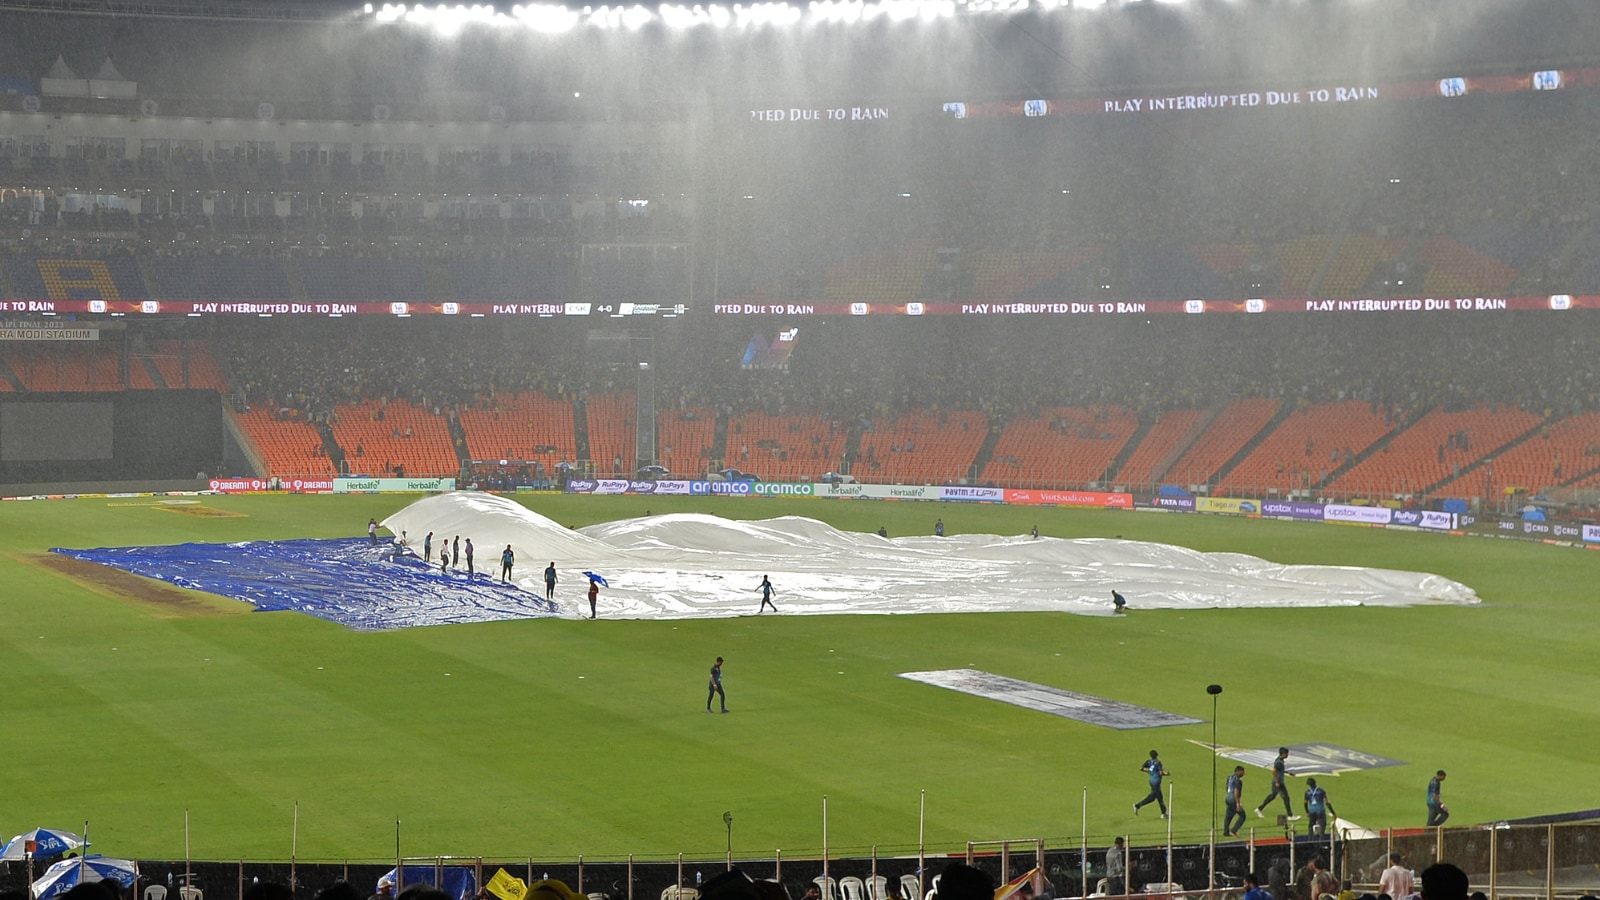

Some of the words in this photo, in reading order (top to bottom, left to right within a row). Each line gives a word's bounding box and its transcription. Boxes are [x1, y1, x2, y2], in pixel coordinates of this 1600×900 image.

[1104, 99, 1143, 112] PLAY
[1149, 93, 1261, 110] INTERRUPTED
[1307, 89, 1329, 102] TO
[1335, 87, 1379, 101] RAIN
[827, 109, 846, 120] TO
[851, 107, 889, 120] RAIN
[12, 301, 26, 311] TO
[29, 301, 55, 311] RAIN
[193, 303, 218, 312] PLAY
[221, 303, 289, 313] INTERRUPTED
[315, 304, 329, 313] TO
[332, 303, 357, 313] RAIN
[493, 304, 518, 314] PLAY
[769, 305, 784, 314] TO
[787, 304, 814, 314] RAIN
[962, 303, 989, 314] PLAY
[992, 302, 1068, 313] INTERRUPTED
[1098, 303, 1114, 313] TO
[1117, 302, 1146, 313] RAIN
[1306, 300, 1335, 311] PLAY
[1338, 299, 1421, 311] INTERRUPTED
[1455, 299, 1471, 310] TO
[1475, 298, 1506, 310] RAIN
[17, 330, 43, 339] MODI
[46, 330, 90, 339] STADIUM
[346, 481, 378, 489] Herbalife
[407, 481, 439, 489] Herbalife
[570, 480, 593, 489] RuPay
[601, 481, 624, 489] RuPay
[630, 481, 652, 490] RuPay
[692, 482, 749, 493] aramco
[755, 483, 811, 494] aramco
[827, 485, 859, 495] Herbalife
[890, 487, 922, 496] Herbalife
[1040, 493, 1095, 502] VisitSaudi.com
[1160, 498, 1177, 506] TATA
[1178, 499, 1192, 507] NEU
[1532, 524, 1549, 532] CRED
[1562, 527, 1579, 535] CRED
